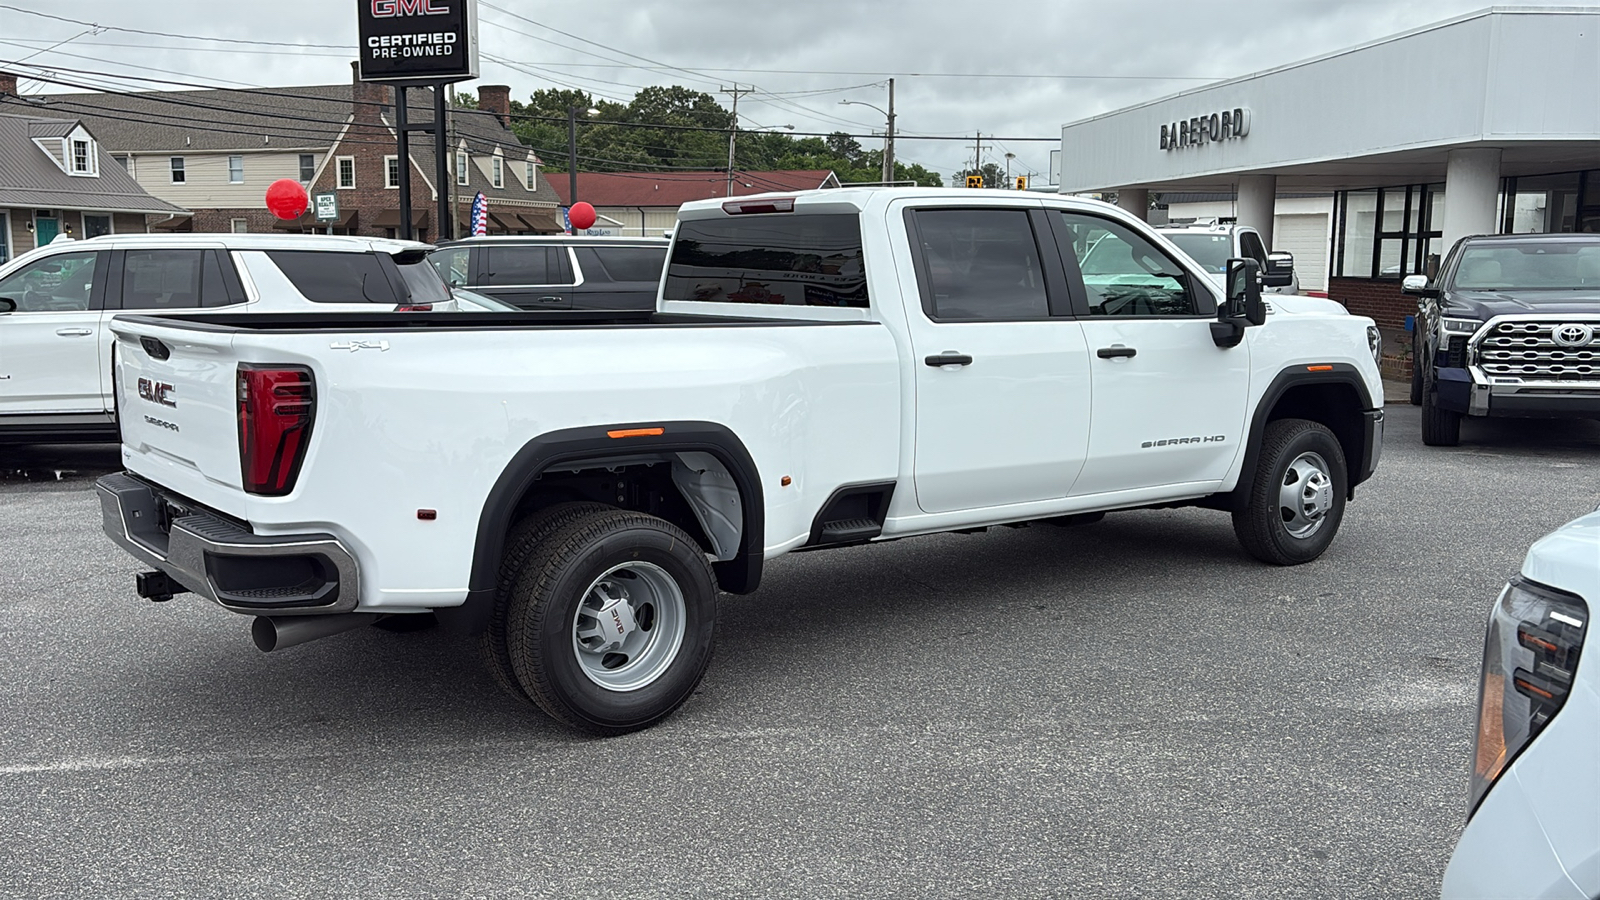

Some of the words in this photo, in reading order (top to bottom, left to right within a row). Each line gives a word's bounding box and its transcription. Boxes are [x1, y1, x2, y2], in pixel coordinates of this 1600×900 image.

[371, 0, 450, 18] GMC
[368, 32, 457, 48] CERTIFIED
[372, 45, 453, 59] PRE-OWNED
[1160, 108, 1248, 150] BAREFORD
[138, 377, 177, 409] GMC
[1141, 436, 1201, 449] SIERRA
[1203, 435, 1226, 443] HD
[611, 608, 625, 635] GMC
